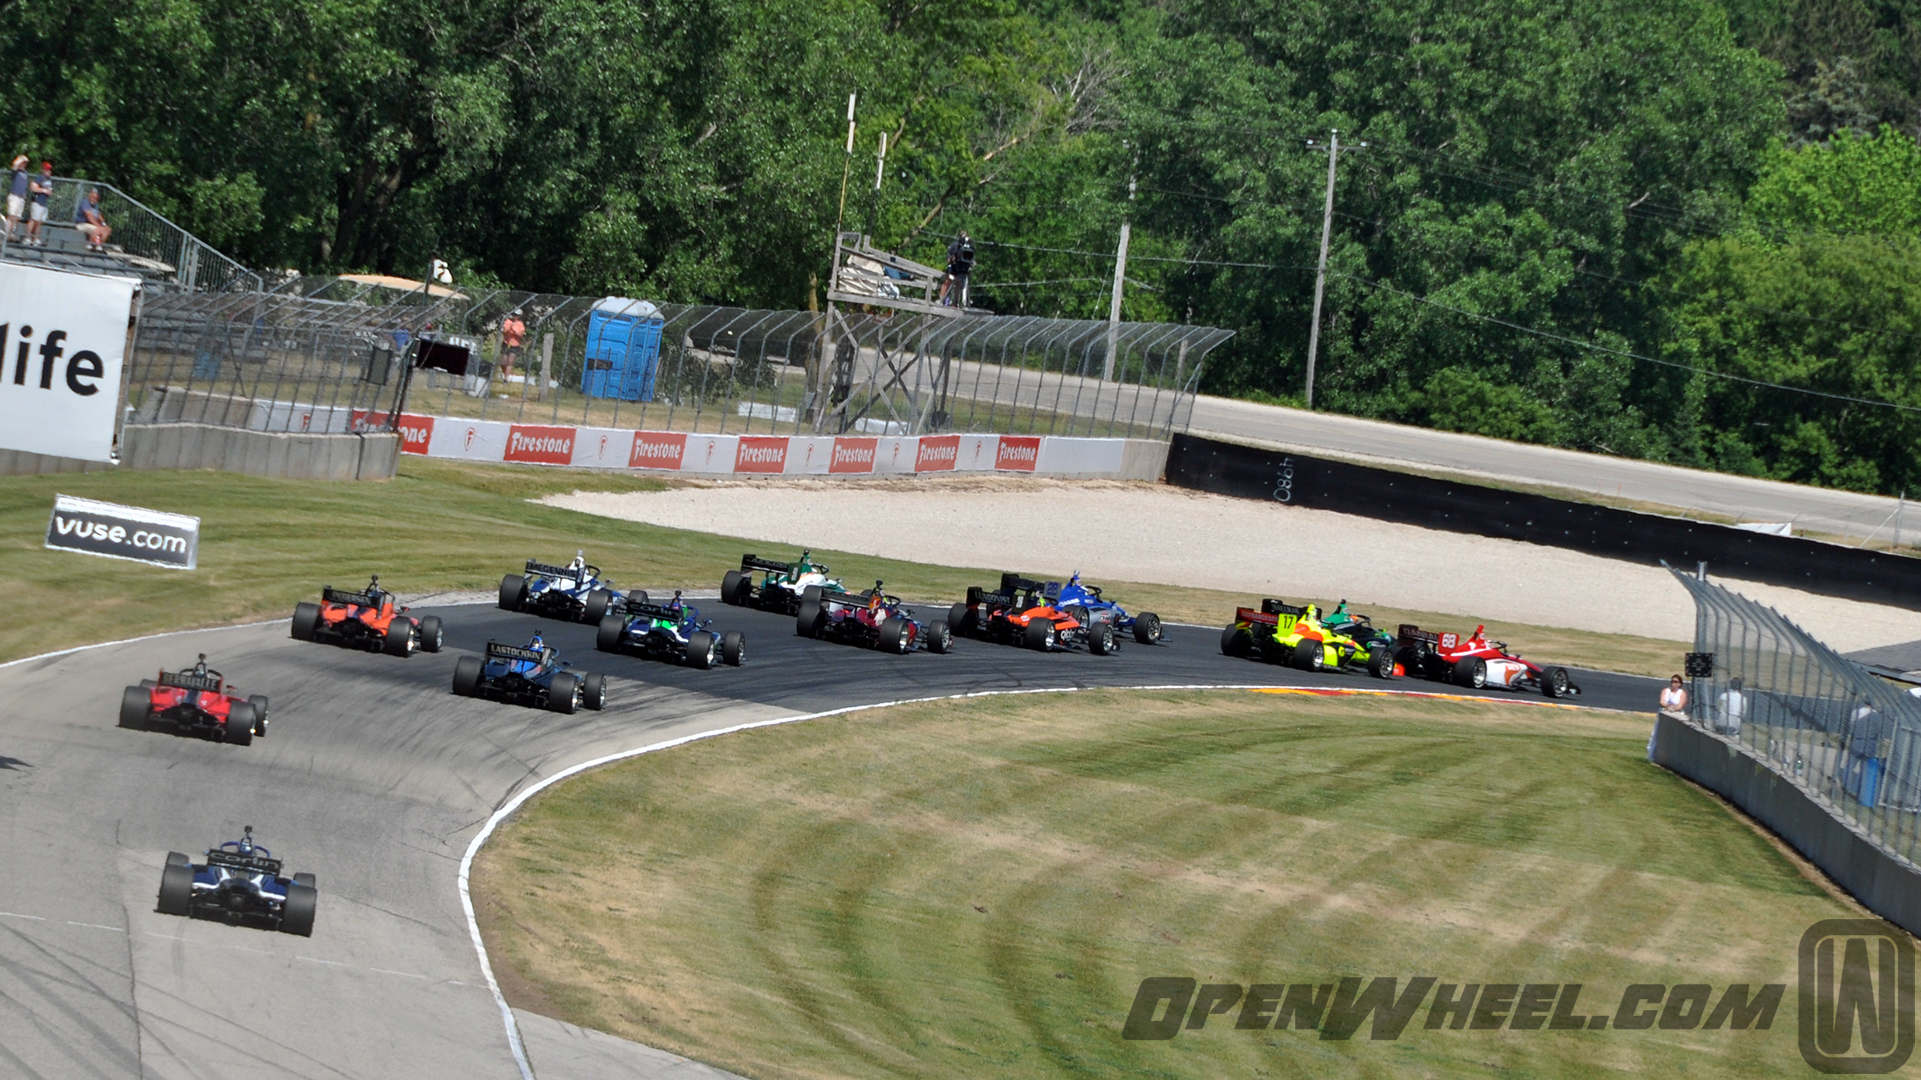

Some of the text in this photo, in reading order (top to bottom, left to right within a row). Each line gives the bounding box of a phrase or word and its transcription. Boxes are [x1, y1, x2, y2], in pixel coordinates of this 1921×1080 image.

[511, 432, 571, 455] Firestone
[633, 438, 682, 461] Firestone
[738, 443, 783, 466] Firestone
[919, 443, 956, 462] Firestone
[999, 441, 1037, 463] Firestone
[833, 444, 873, 466] Firestone
[55, 516, 187, 554] vuse.com
[529, 562, 577, 578] MEGENNIS
[629, 602, 679, 617] carlin
[1283, 615, 1295, 629] 17
[1441, 633, 1457, 649] 68
